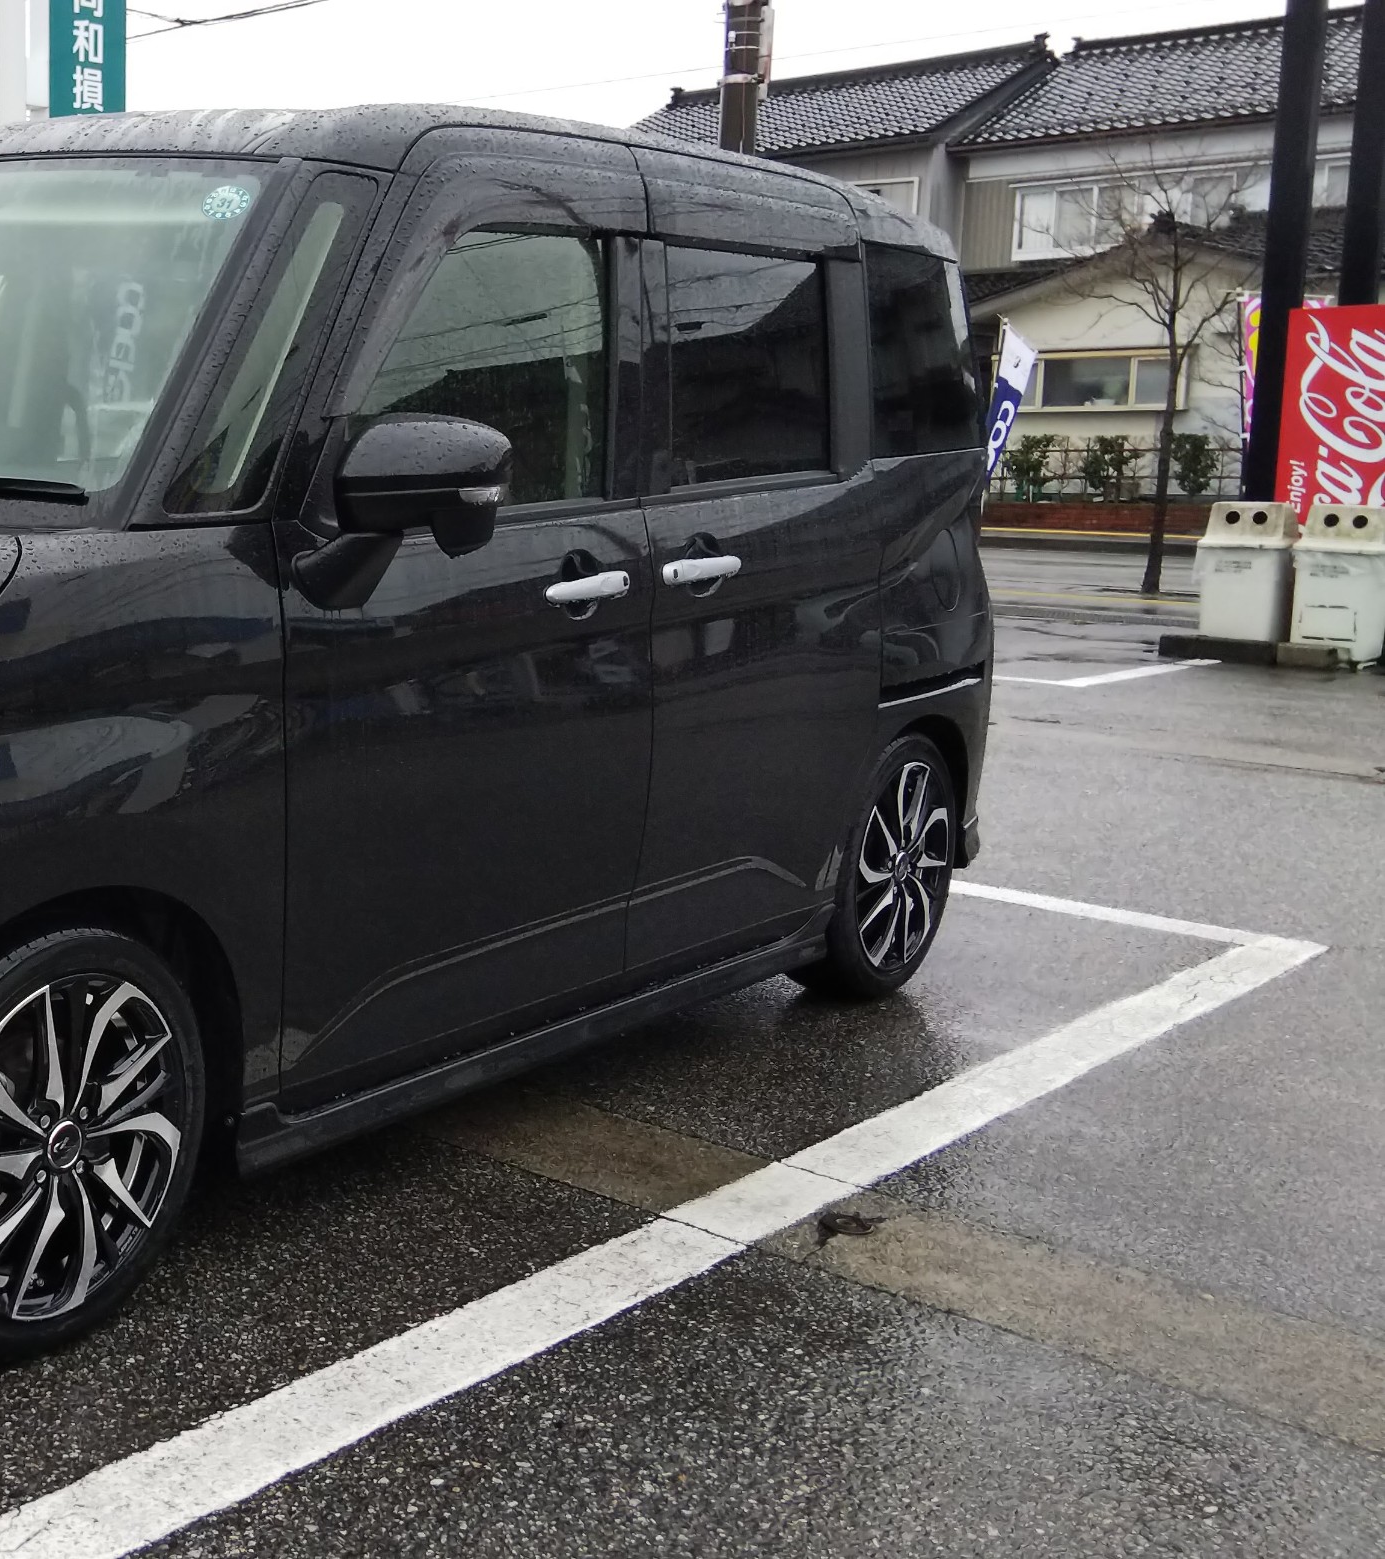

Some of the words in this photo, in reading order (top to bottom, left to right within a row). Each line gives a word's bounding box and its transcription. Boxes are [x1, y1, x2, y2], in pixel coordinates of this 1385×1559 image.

[217, 198, 233, 209] 31
[1299, 313, 1385, 506] a-Cola
[1286, 459, 1308, 514] Enjoy!
